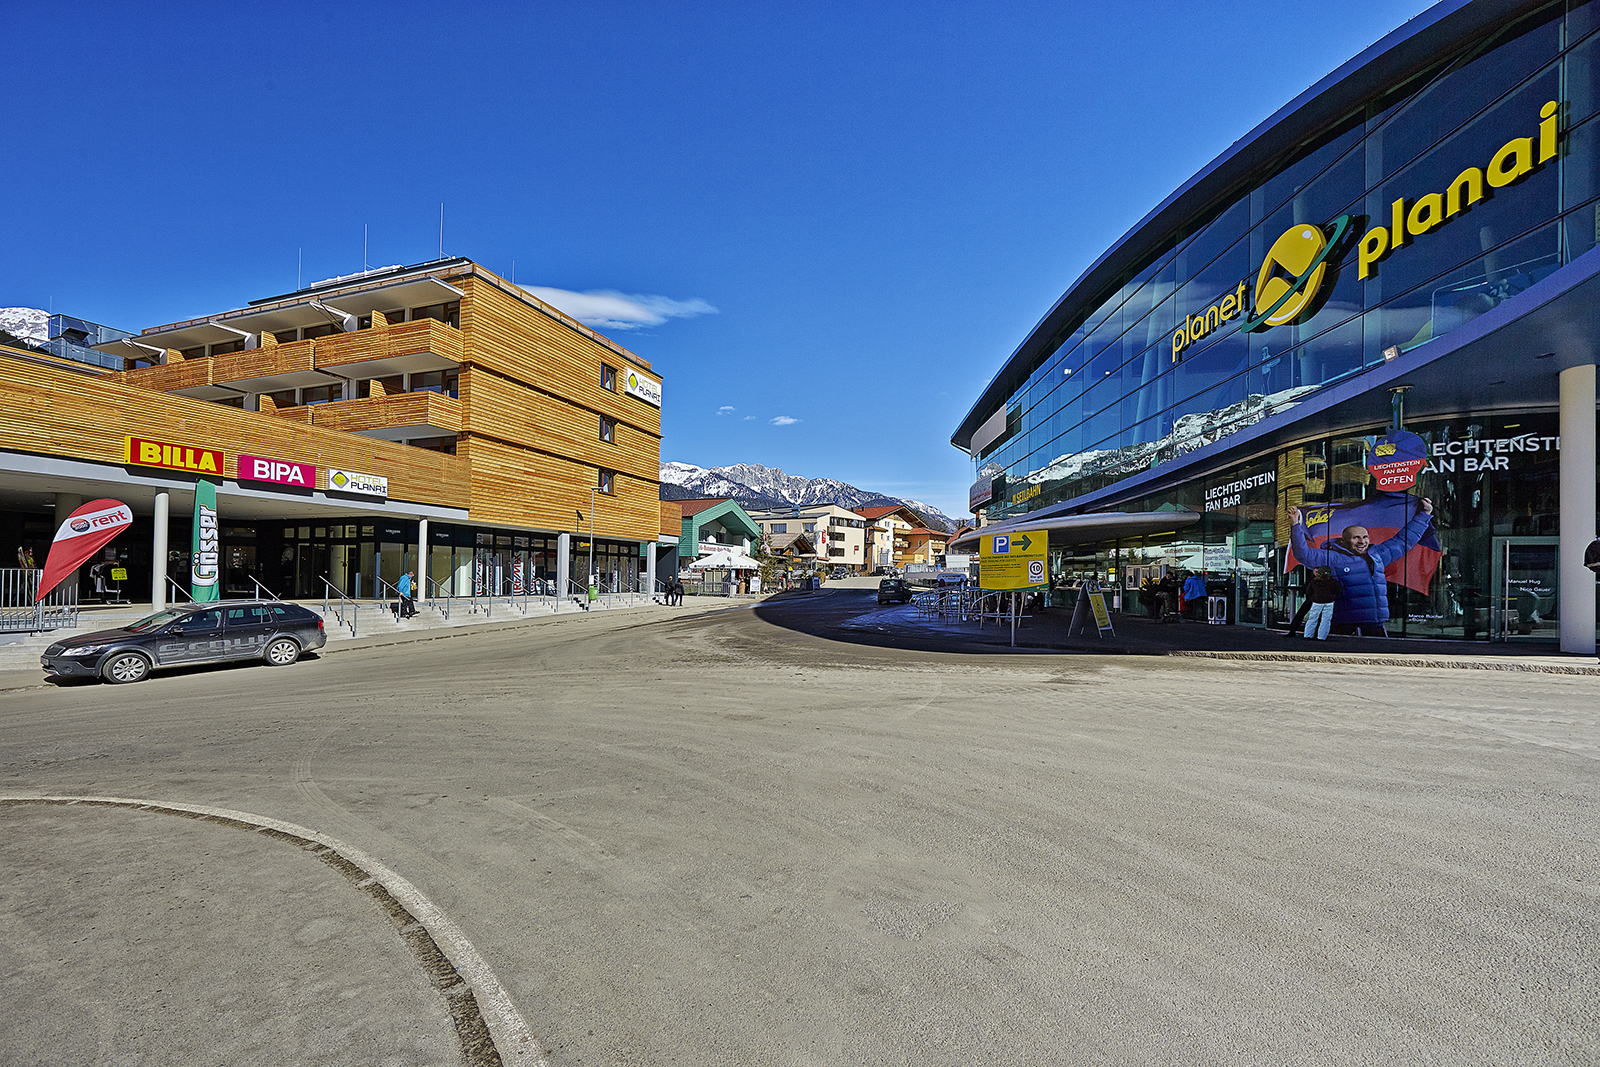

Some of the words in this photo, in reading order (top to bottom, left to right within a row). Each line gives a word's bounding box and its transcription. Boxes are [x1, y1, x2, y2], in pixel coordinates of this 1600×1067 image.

[1357, 99, 1559, 282] planai
[1171, 279, 1249, 364] planet
[639, 377, 659, 394] HOTEL
[639, 385, 661, 402] PLANAI
[1428, 436, 1560, 457] ECHTENST
[139, 441, 217, 472] BILLA
[1373, 459, 1421, 471] LIECHTENSTEIN
[1421, 458, 1456, 475] AN
[1463, 456, 1509, 472] BAR
[253, 459, 305, 484] BIPA
[1379, 474, 1414, 486] OFFEN
[1383, 467, 1397, 475] FAN
[1397, 466, 1410, 474] BAR
[350, 474, 384, 487] HOTEL
[350, 481, 387, 494] PLANAI
[1204, 470, 1276, 501] LIECHTENSTEIN
[1016, 483, 1042, 503] SEILBAHN
[1204, 500, 1221, 512] FAN
[1223, 494, 1241, 509] BAR
[91, 509, 128, 528] rent
[191, 503, 220, 586] Gösser
[996, 536, 1008, 553] P
[513, 553, 522, 590] RE/MAX
